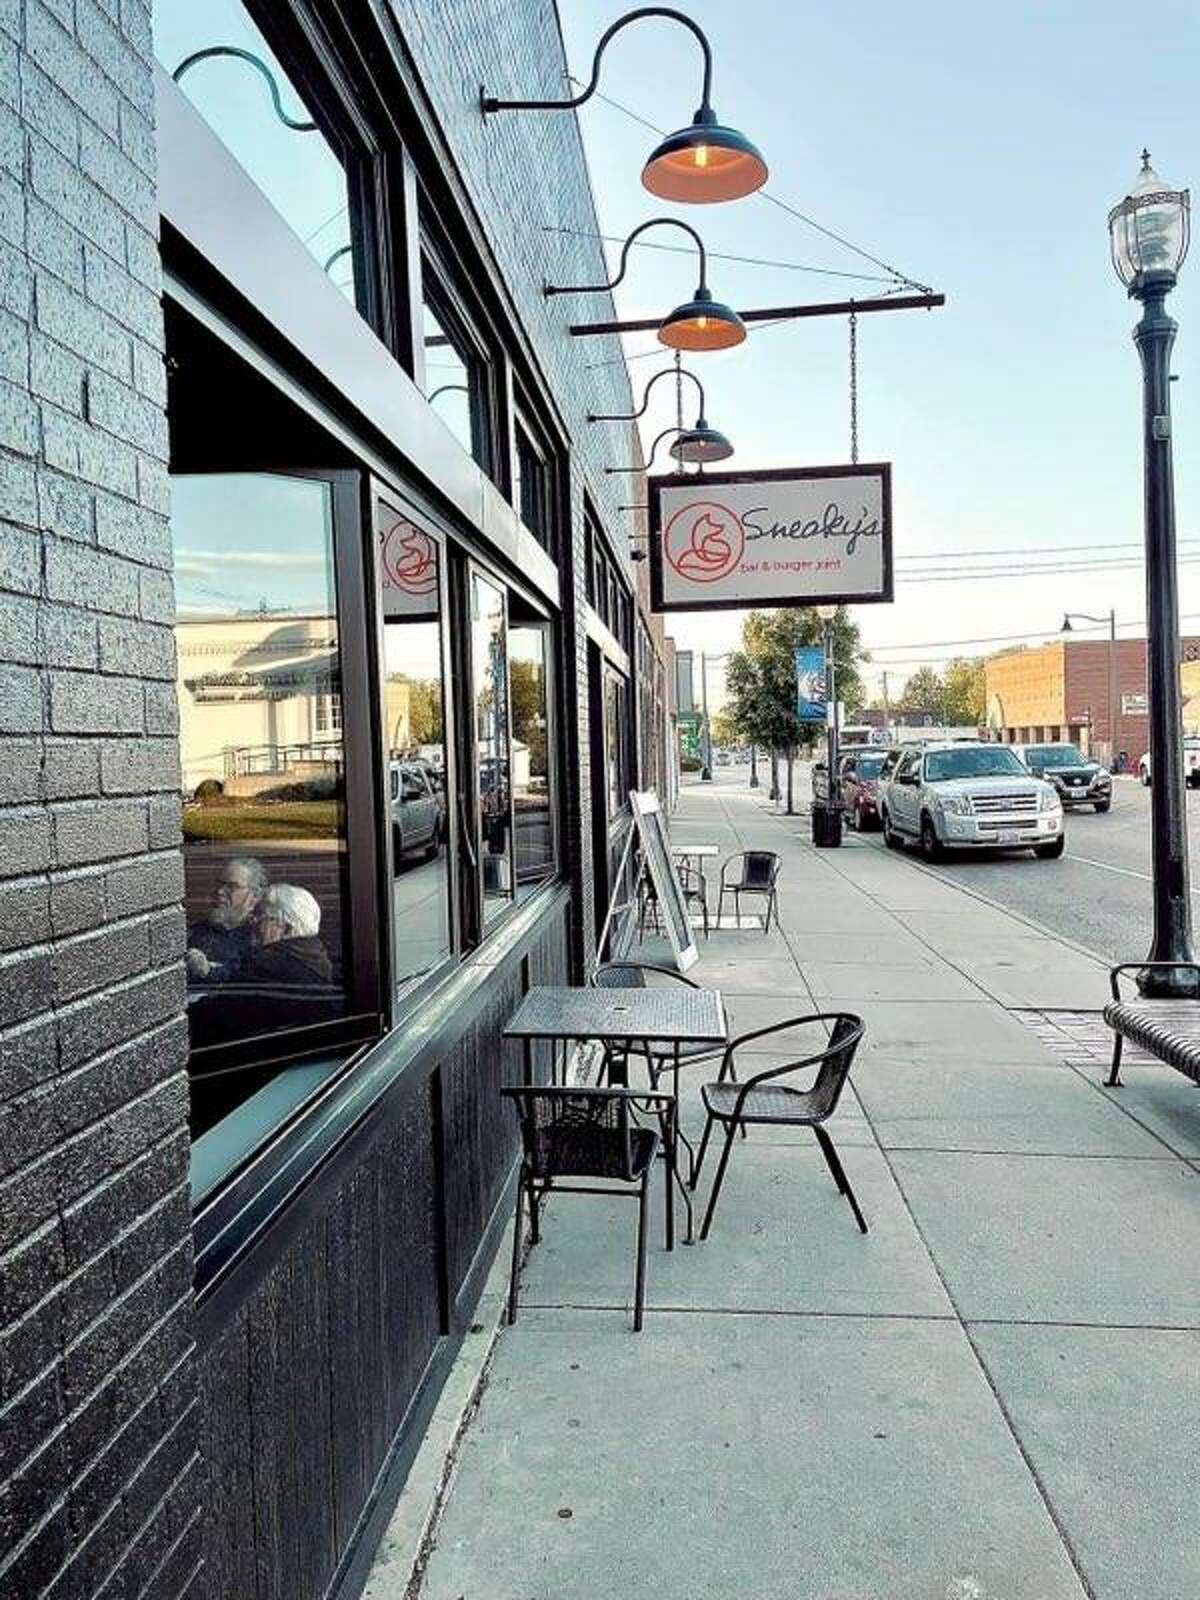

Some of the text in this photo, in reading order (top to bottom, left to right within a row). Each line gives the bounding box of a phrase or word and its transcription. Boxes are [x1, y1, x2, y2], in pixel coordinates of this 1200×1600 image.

[741, 503, 882, 555] Sneaky's
[740, 558, 842, 573] bar & burger joint
